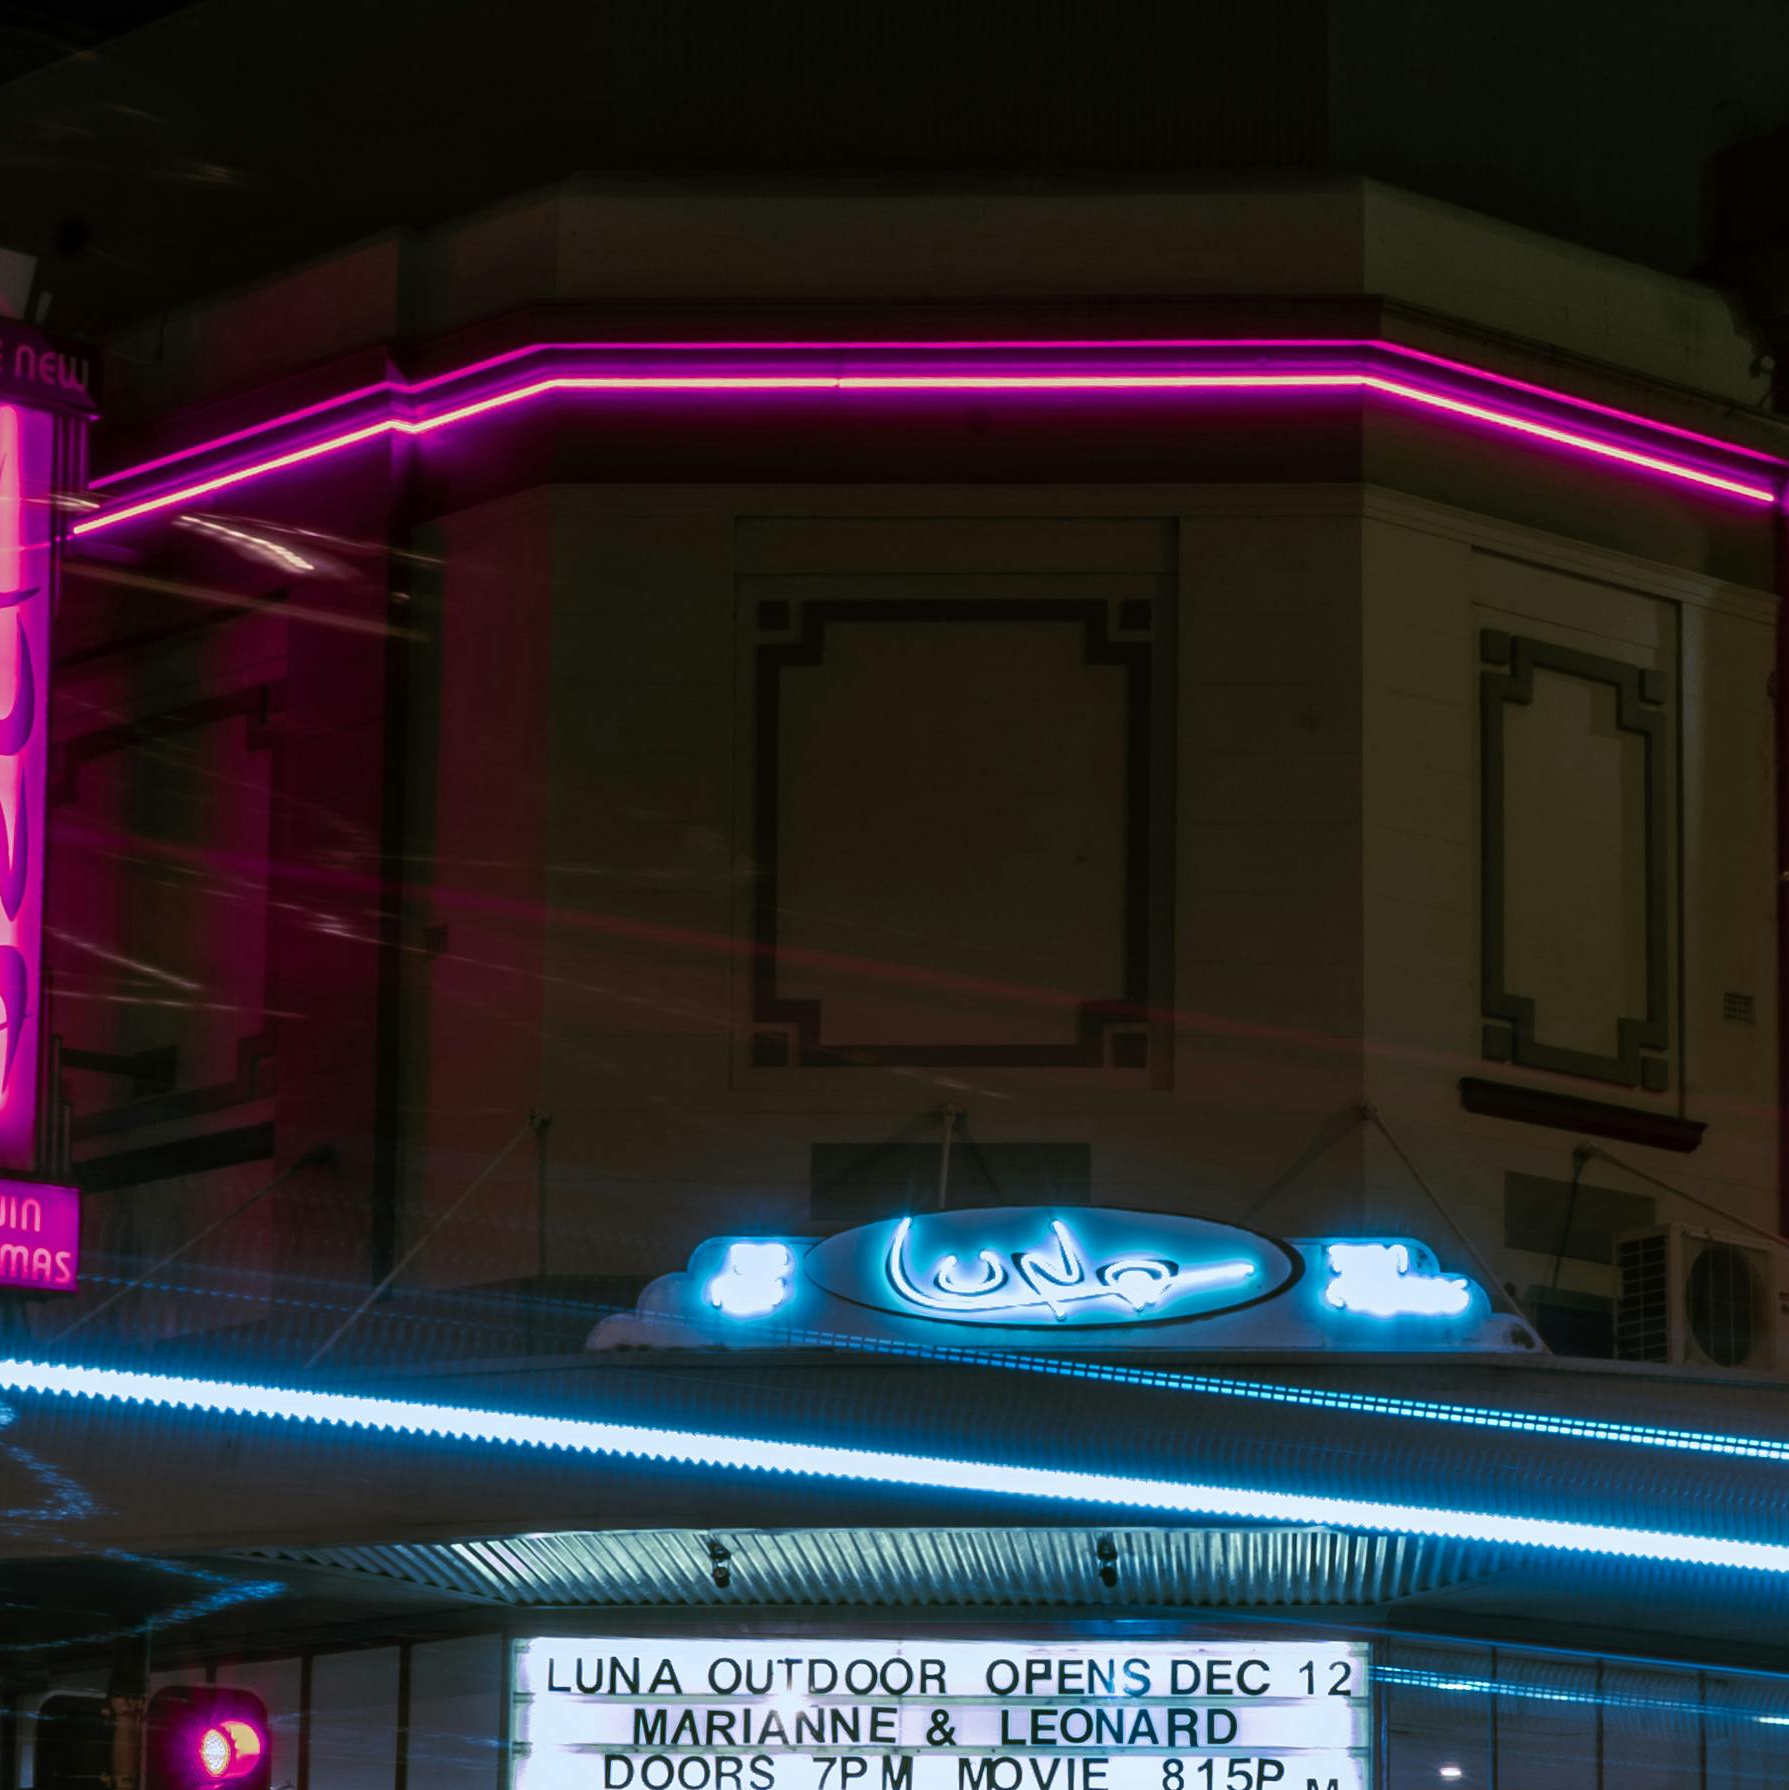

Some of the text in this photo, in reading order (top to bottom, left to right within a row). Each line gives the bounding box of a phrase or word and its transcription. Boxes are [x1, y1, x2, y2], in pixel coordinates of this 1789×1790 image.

[12, 341, 91, 393] NEW
[547, 1657, 1351, 1696] LUNA OUTDOOR OPENS DEC 12
[634, 1707, 1238, 1747] MARIANNE & LEONARD
[605, 1755, 775, 1790] DOORS
